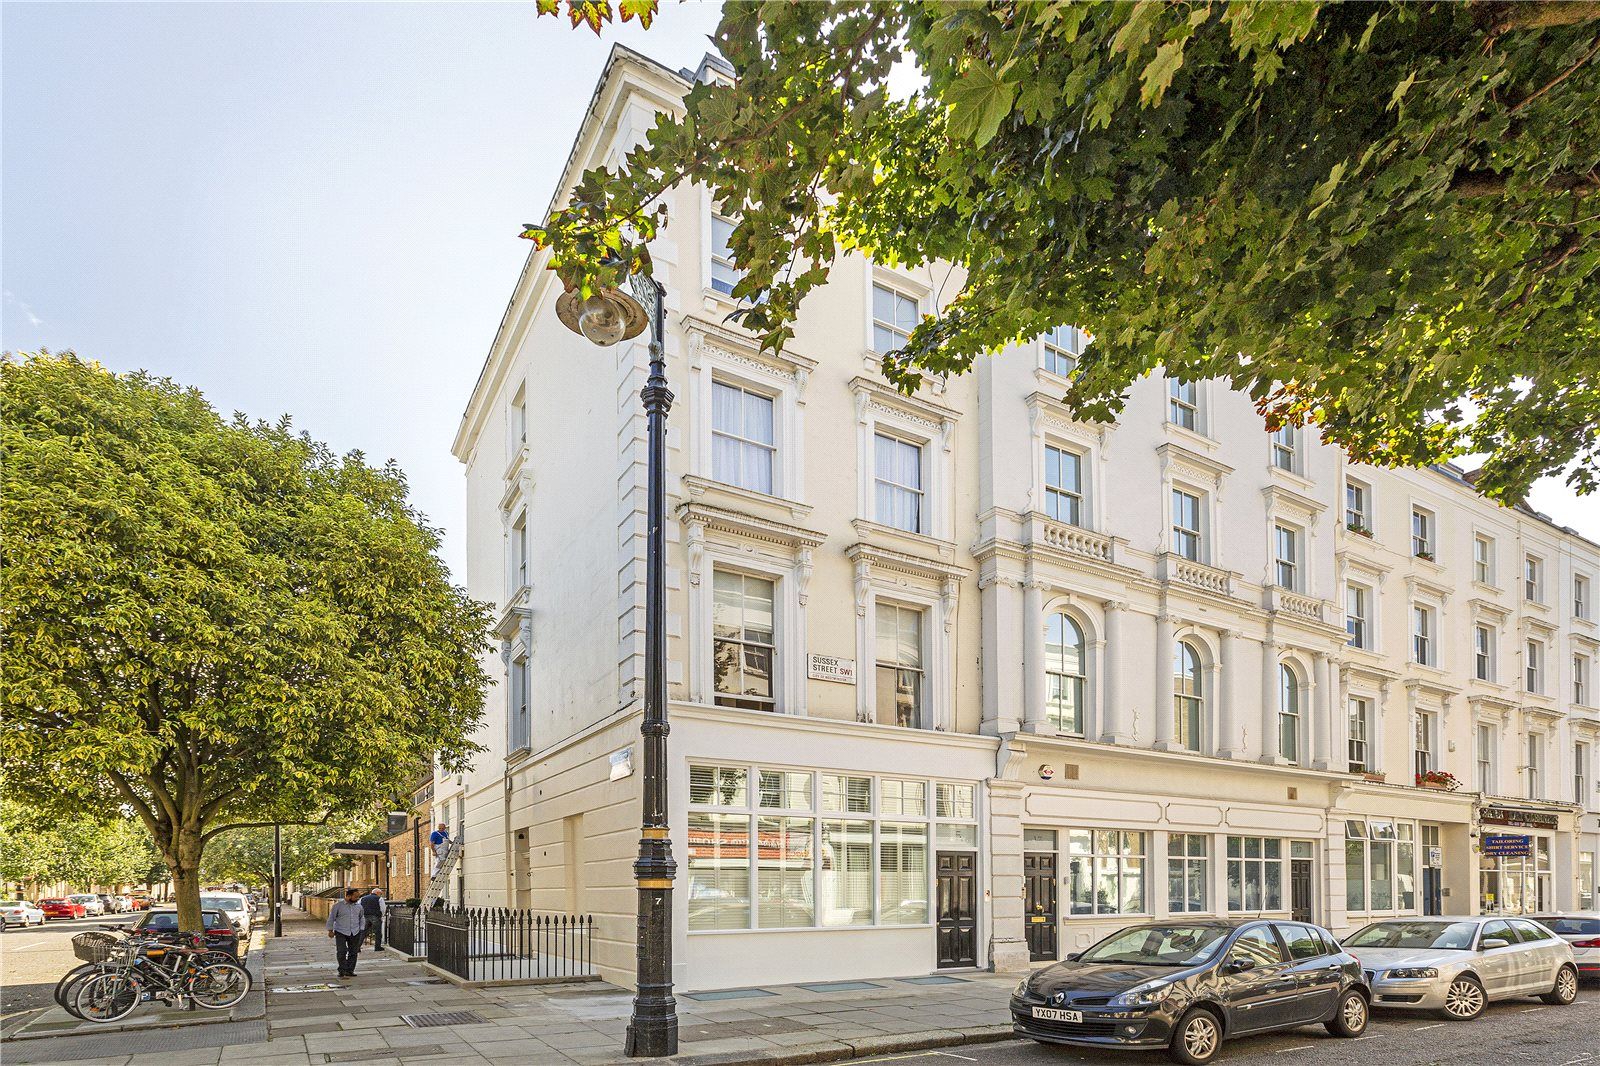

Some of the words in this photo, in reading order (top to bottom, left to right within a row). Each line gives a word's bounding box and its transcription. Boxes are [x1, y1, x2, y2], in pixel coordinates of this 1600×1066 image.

[812, 656, 838, 666] SUSSEX
[812, 664, 837, 673] STREET
[840, 668, 853, 676] SW1
[655, 897, 662, 905] 7
[1035, 1008, 1057, 1019] YX07
[1060, 1011, 1079, 1022] HSA
